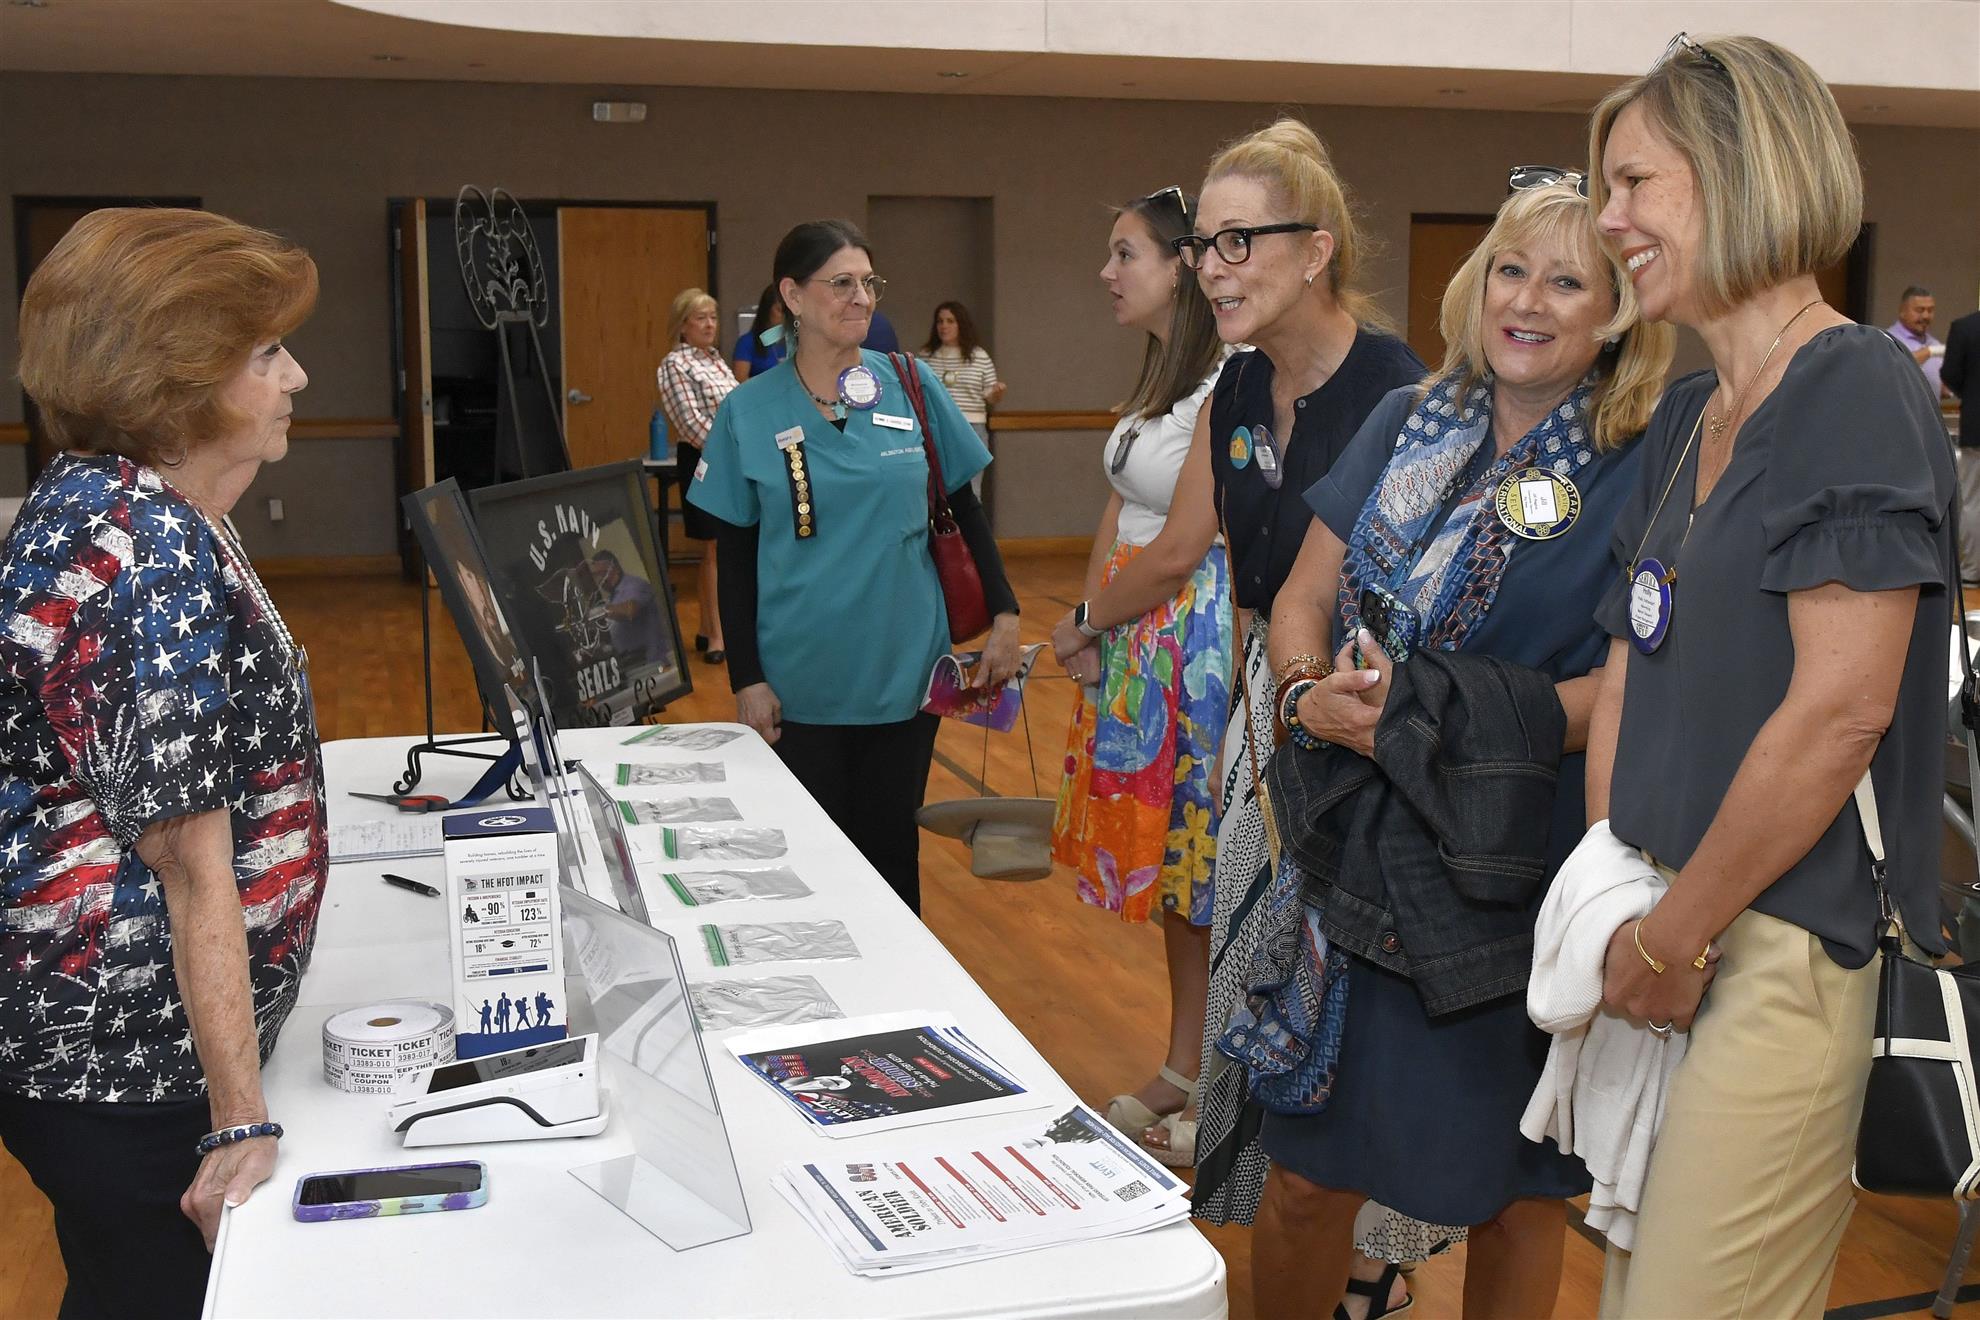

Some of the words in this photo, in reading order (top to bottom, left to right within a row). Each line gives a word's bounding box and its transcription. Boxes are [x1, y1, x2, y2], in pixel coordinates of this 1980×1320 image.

[1498, 474, 1527, 535] INTERNATIONAL
[1560, 479, 1577, 521] ROTARY
[529, 520, 557, 571] U.S.
[555, 503, 600, 549] NAVY
[577, 656, 621, 702] SEALS
[481, 878, 494, 889] THE
[497, 876, 514, 887] HFOT
[517, 874, 543, 886] IMPACT
[350, 1047, 392, 1057] TICKET
[353, 1059, 391, 1067] 13383-010
[415, 1062, 433, 1070] THIS
[353, 1085, 392, 1094] 13383-010
[855, 1190, 915, 1237] AMERICAN
[882, 1190, 931, 1231] SOLDIER
